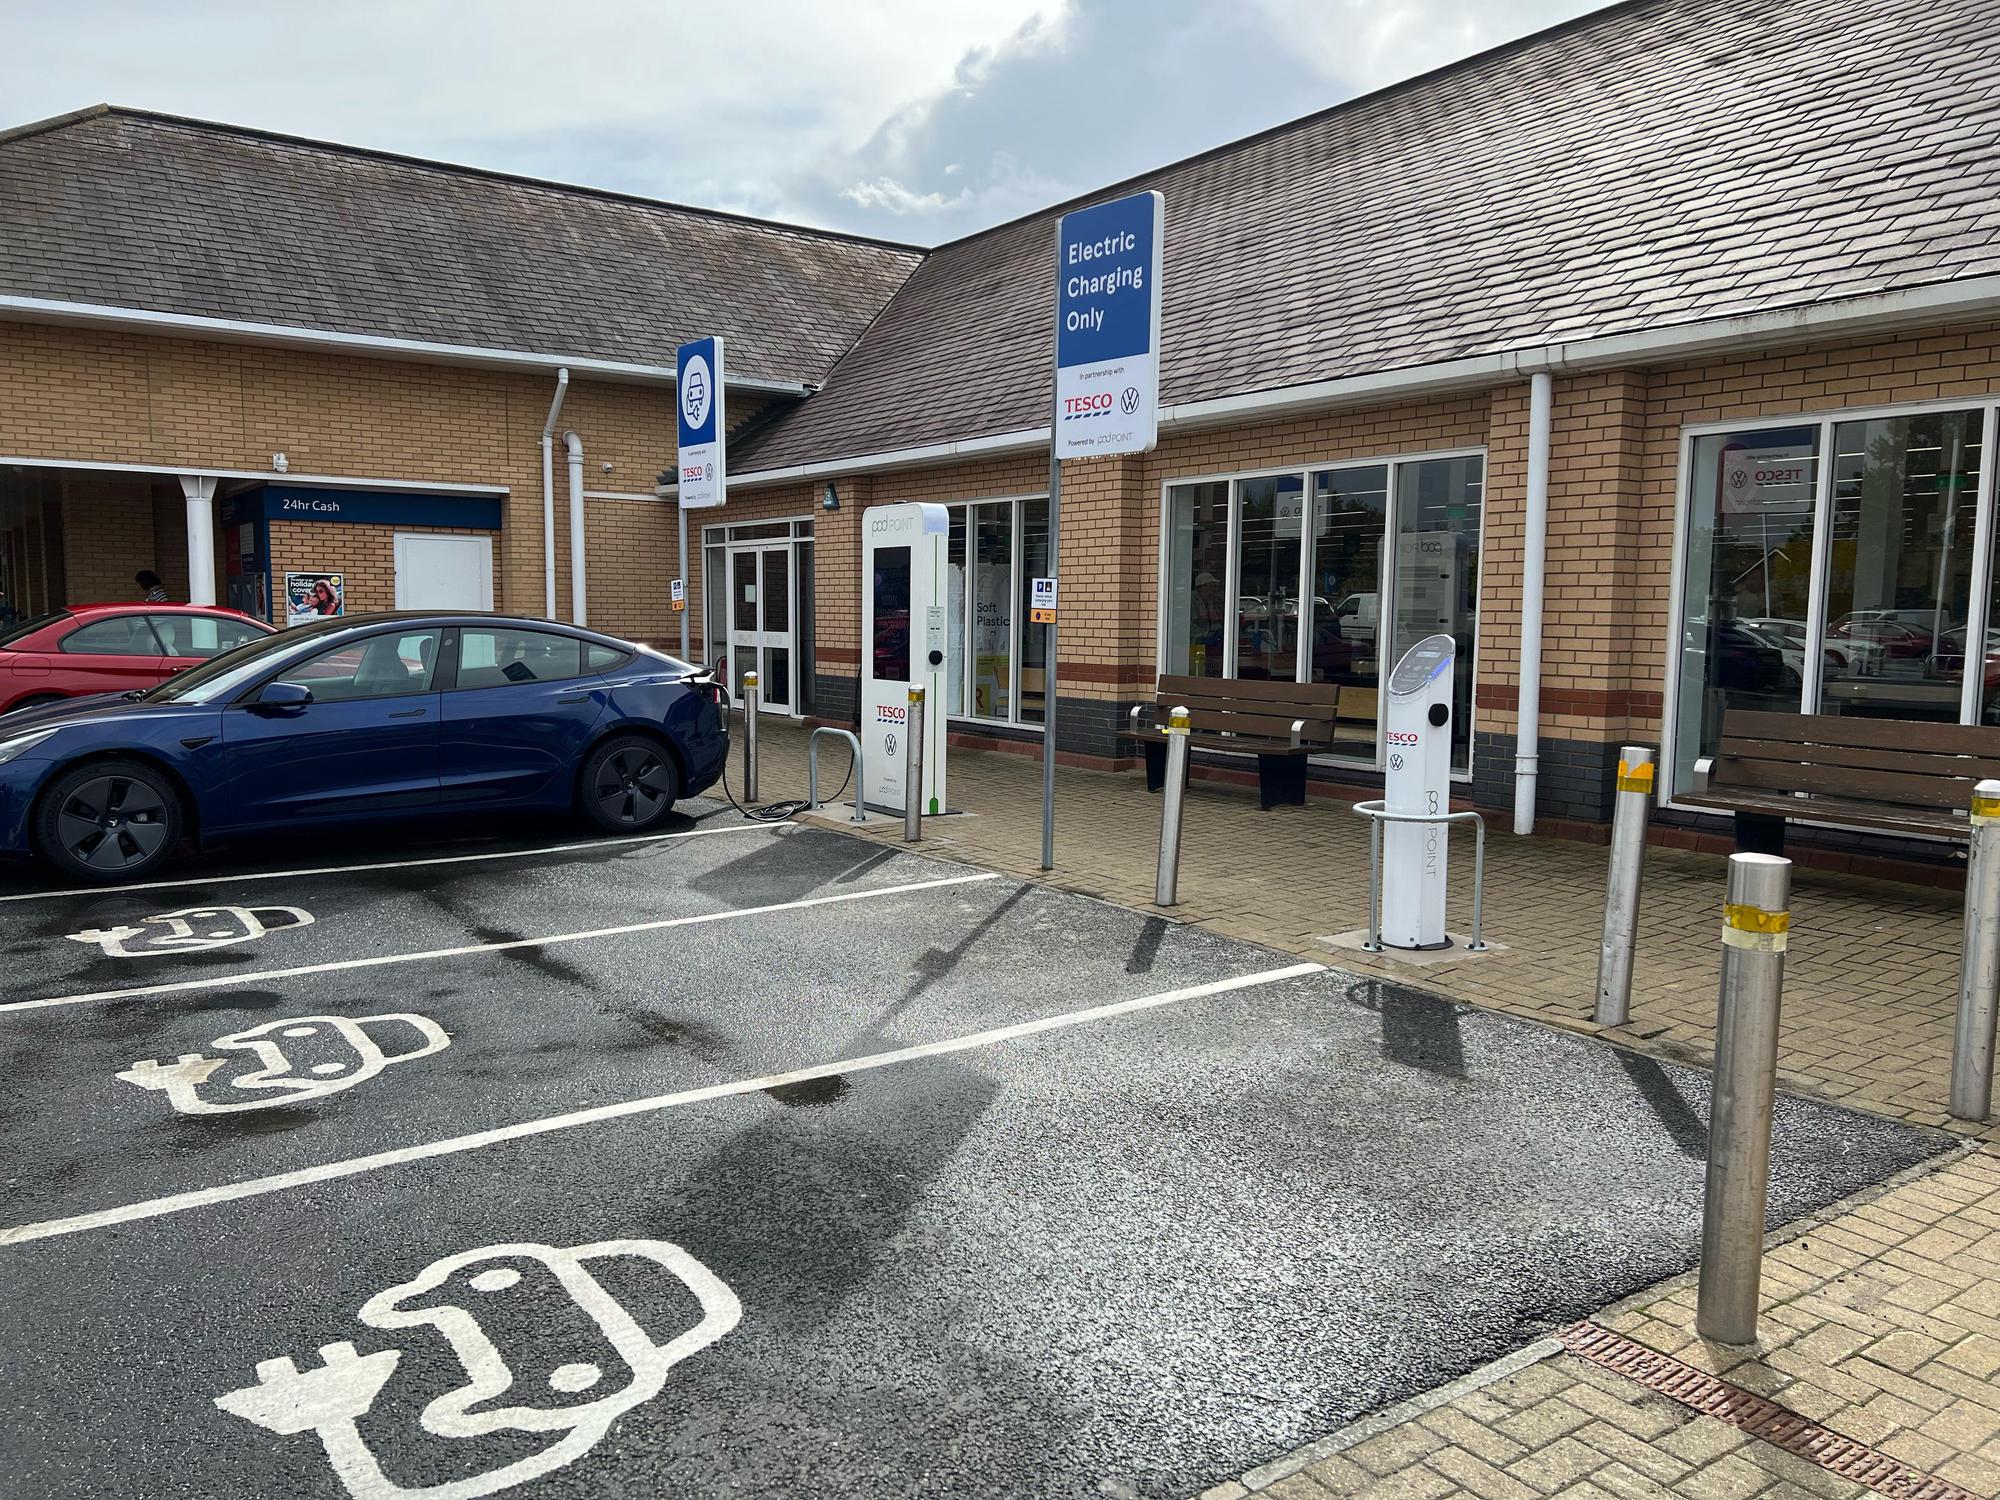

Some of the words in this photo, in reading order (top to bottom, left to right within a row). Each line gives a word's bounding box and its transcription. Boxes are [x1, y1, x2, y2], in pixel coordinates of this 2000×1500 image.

[1068, 230, 1136, 265] Electric
[1067, 265, 1143, 298] Charging
[1066, 306, 1105, 332] Only
[1084, 369, 1113, 380] partnership
[1113, 367, 1125, 375] with
[1064, 393, 1113, 413] TESCO
[1067, 437, 1088, 447] Powered
[1088, 437, 1095, 446] by
[682, 465, 703, 478] TESCO
[283, 499, 310, 510] 24hr
[312, 500, 340, 512] Cash
[871, 512, 888, 537] pod
[888, 517, 915, 532] POINT
[290, 580, 315, 588] holiday
[976, 602, 997, 613] Soft
[876, 705, 906, 720] TESCO
[1386, 732, 1418, 743] TESCO
[1425, 790, 1439, 816] po
[1425, 827, 1438, 878] POINT
